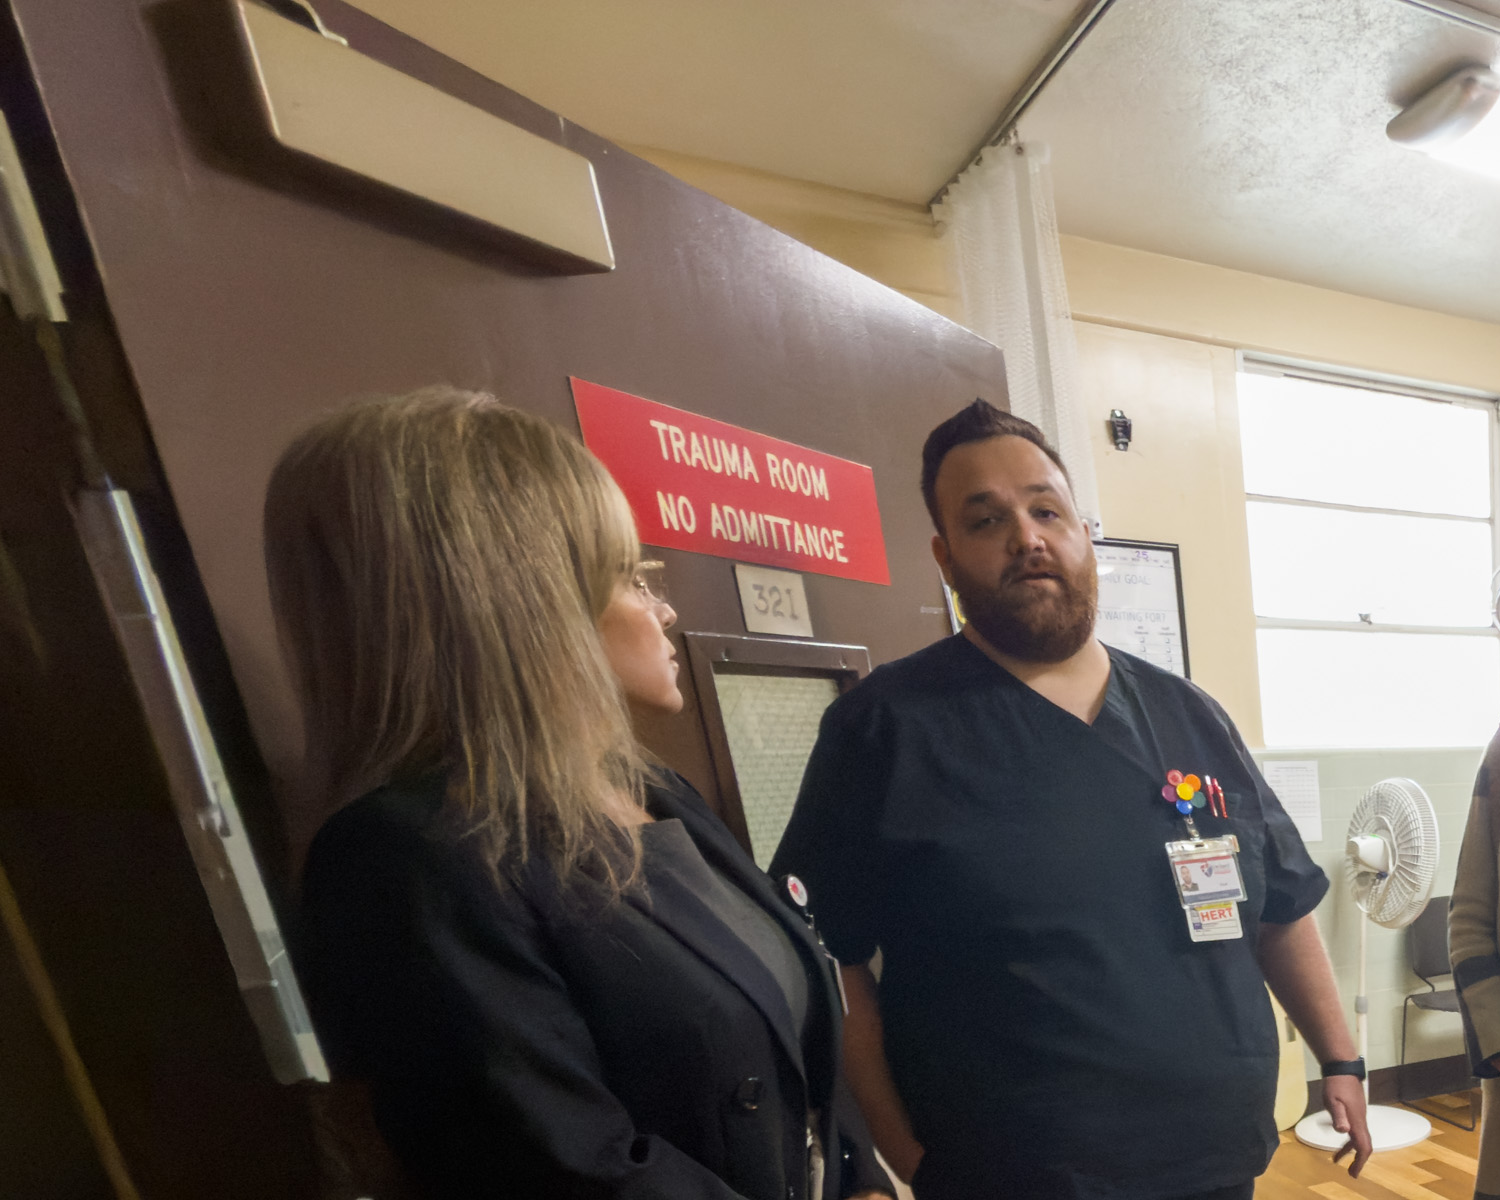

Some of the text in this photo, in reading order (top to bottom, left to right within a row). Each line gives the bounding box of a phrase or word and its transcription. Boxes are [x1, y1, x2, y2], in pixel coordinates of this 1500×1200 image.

[650, 419, 830, 501] TRAUMA ROOM
[656, 490, 849, 563] NO ADMITTANCE
[752, 583, 799, 620] 321
[1200, 907, 1233, 922] HERT
